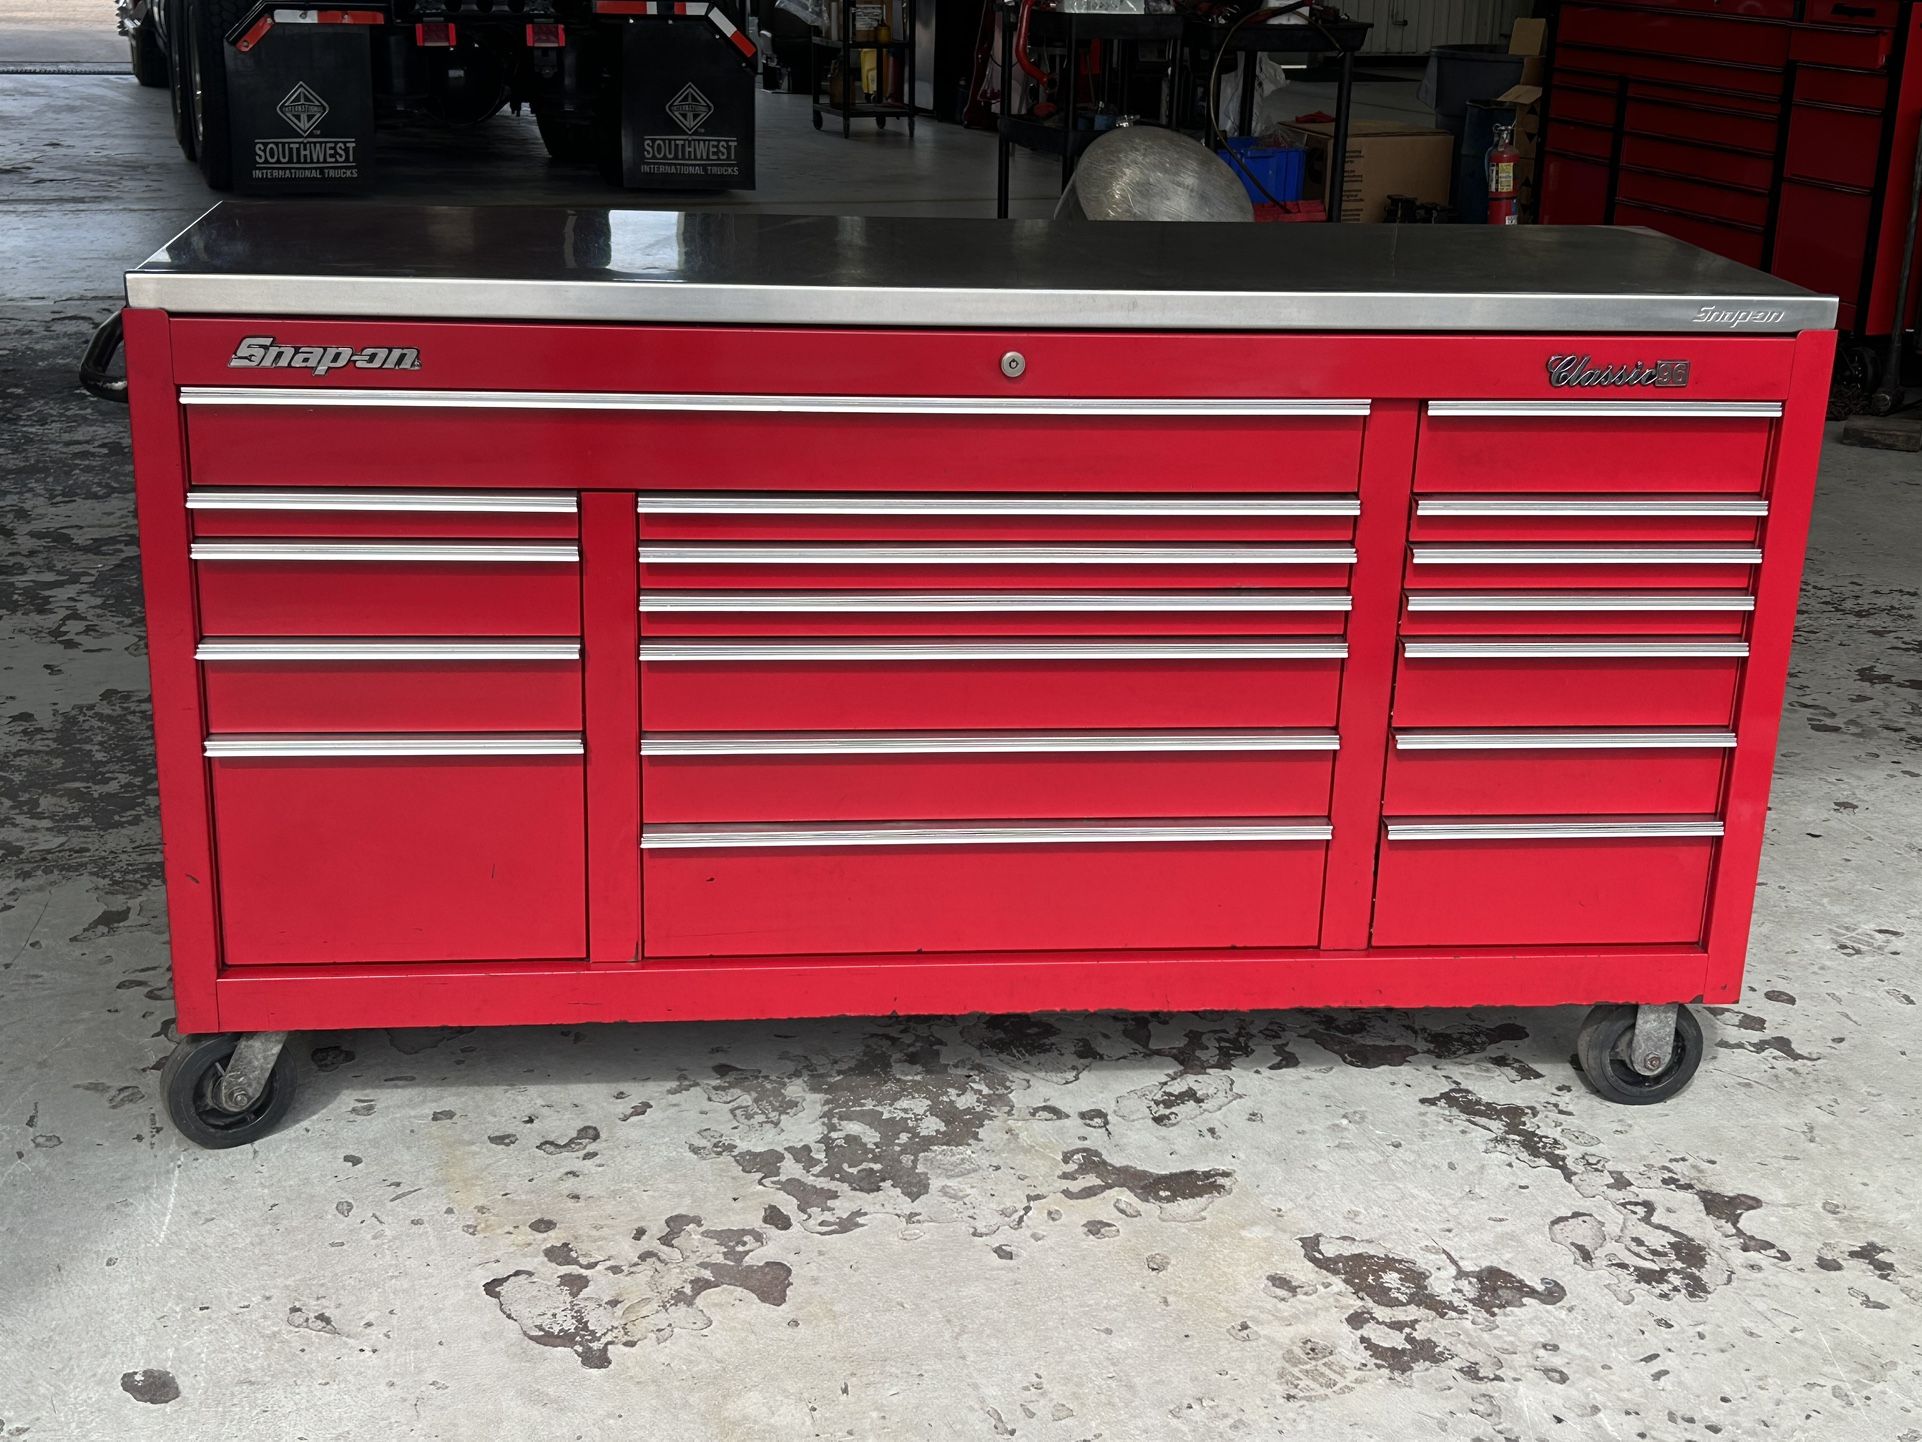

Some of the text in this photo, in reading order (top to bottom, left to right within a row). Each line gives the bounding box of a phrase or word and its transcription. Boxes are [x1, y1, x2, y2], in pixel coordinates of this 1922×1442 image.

[254, 142, 356, 163] SOUTHWEST
[643, 139, 738, 160] SOUTHWEST
[252, 168, 358, 179] INTERNATIONAL TRUCKS
[641, 164, 739, 175] INTERNATIONAL TRUCKS
[1692, 305, 1786, 328] Snap-on
[228, 336, 420, 376] Snap-on
[1546, 354, 1658, 387] Classic
